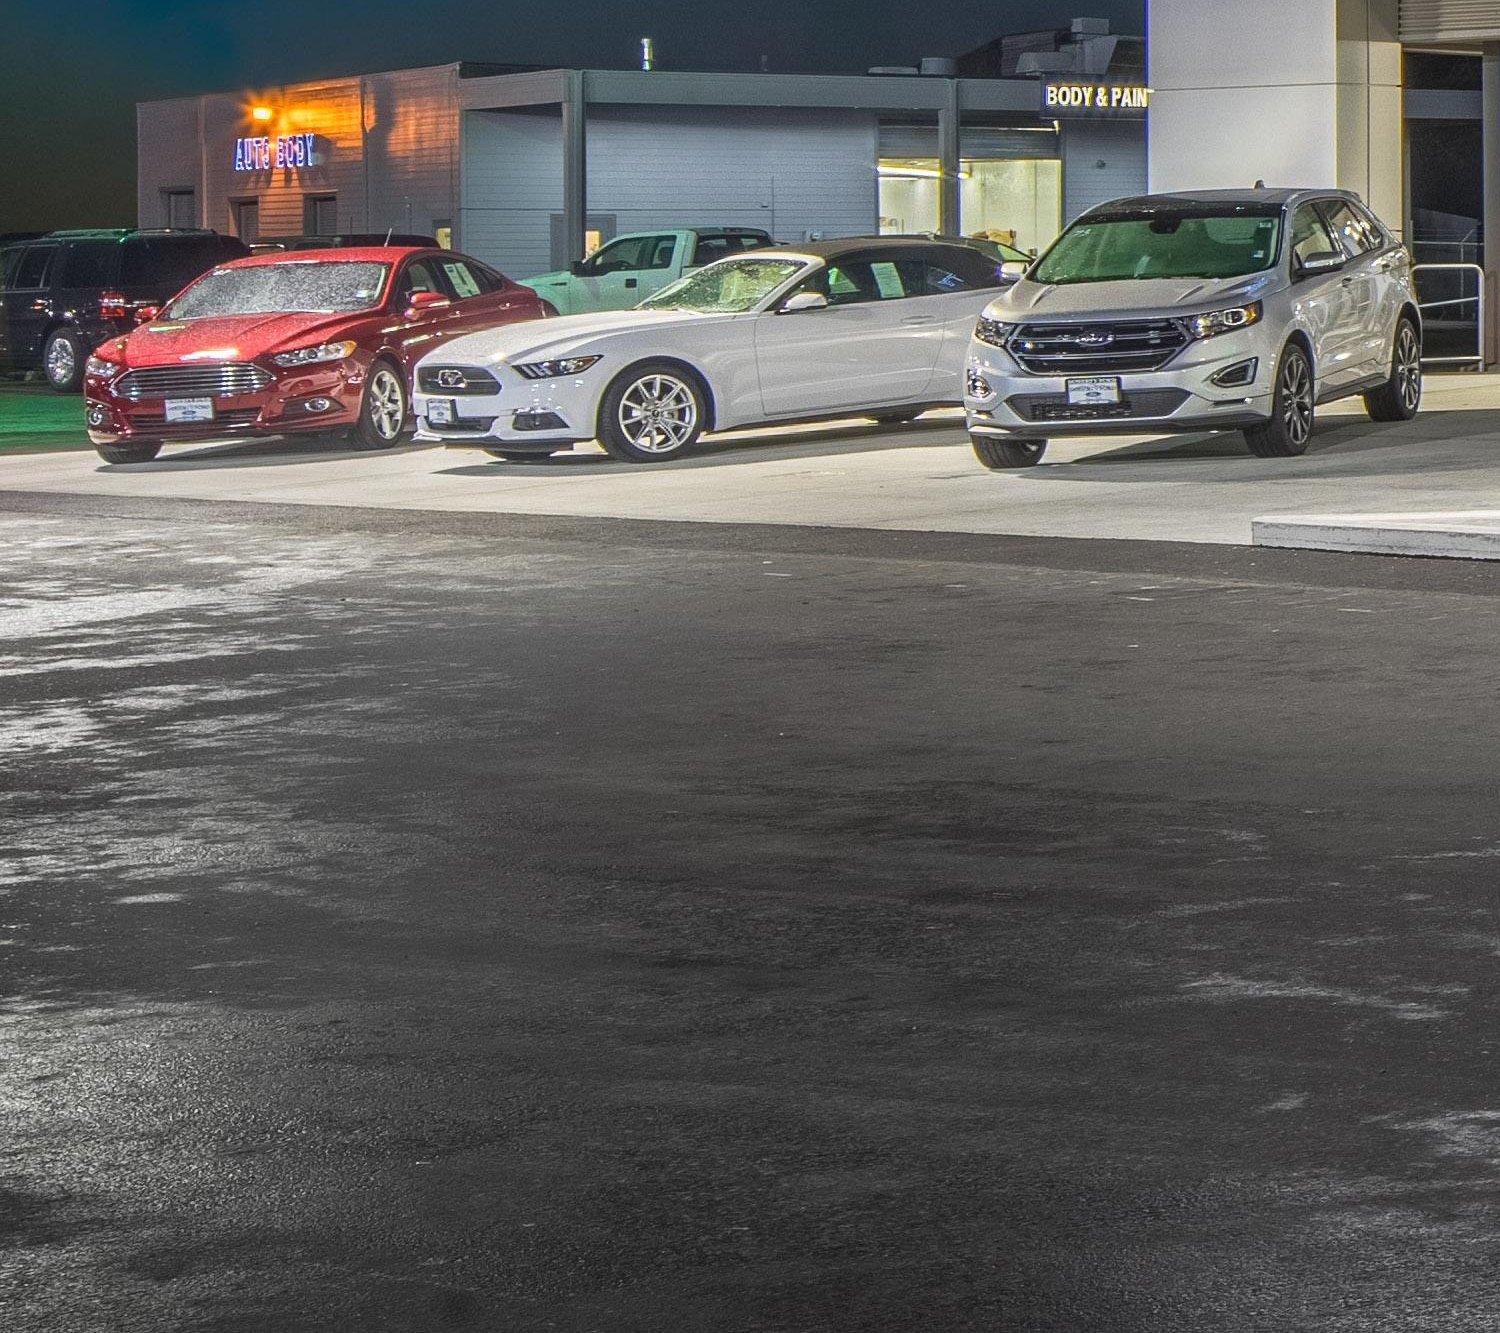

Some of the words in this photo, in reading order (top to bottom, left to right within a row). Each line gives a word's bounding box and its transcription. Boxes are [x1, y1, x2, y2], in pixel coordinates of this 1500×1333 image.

[1044, 85, 1093, 107] BODY
[1095, 86, 1108, 107] &
[1111, 87, 1154, 108] PAIN
[234, 136, 270, 171] AUTO
[276, 133, 315, 168] BODY
